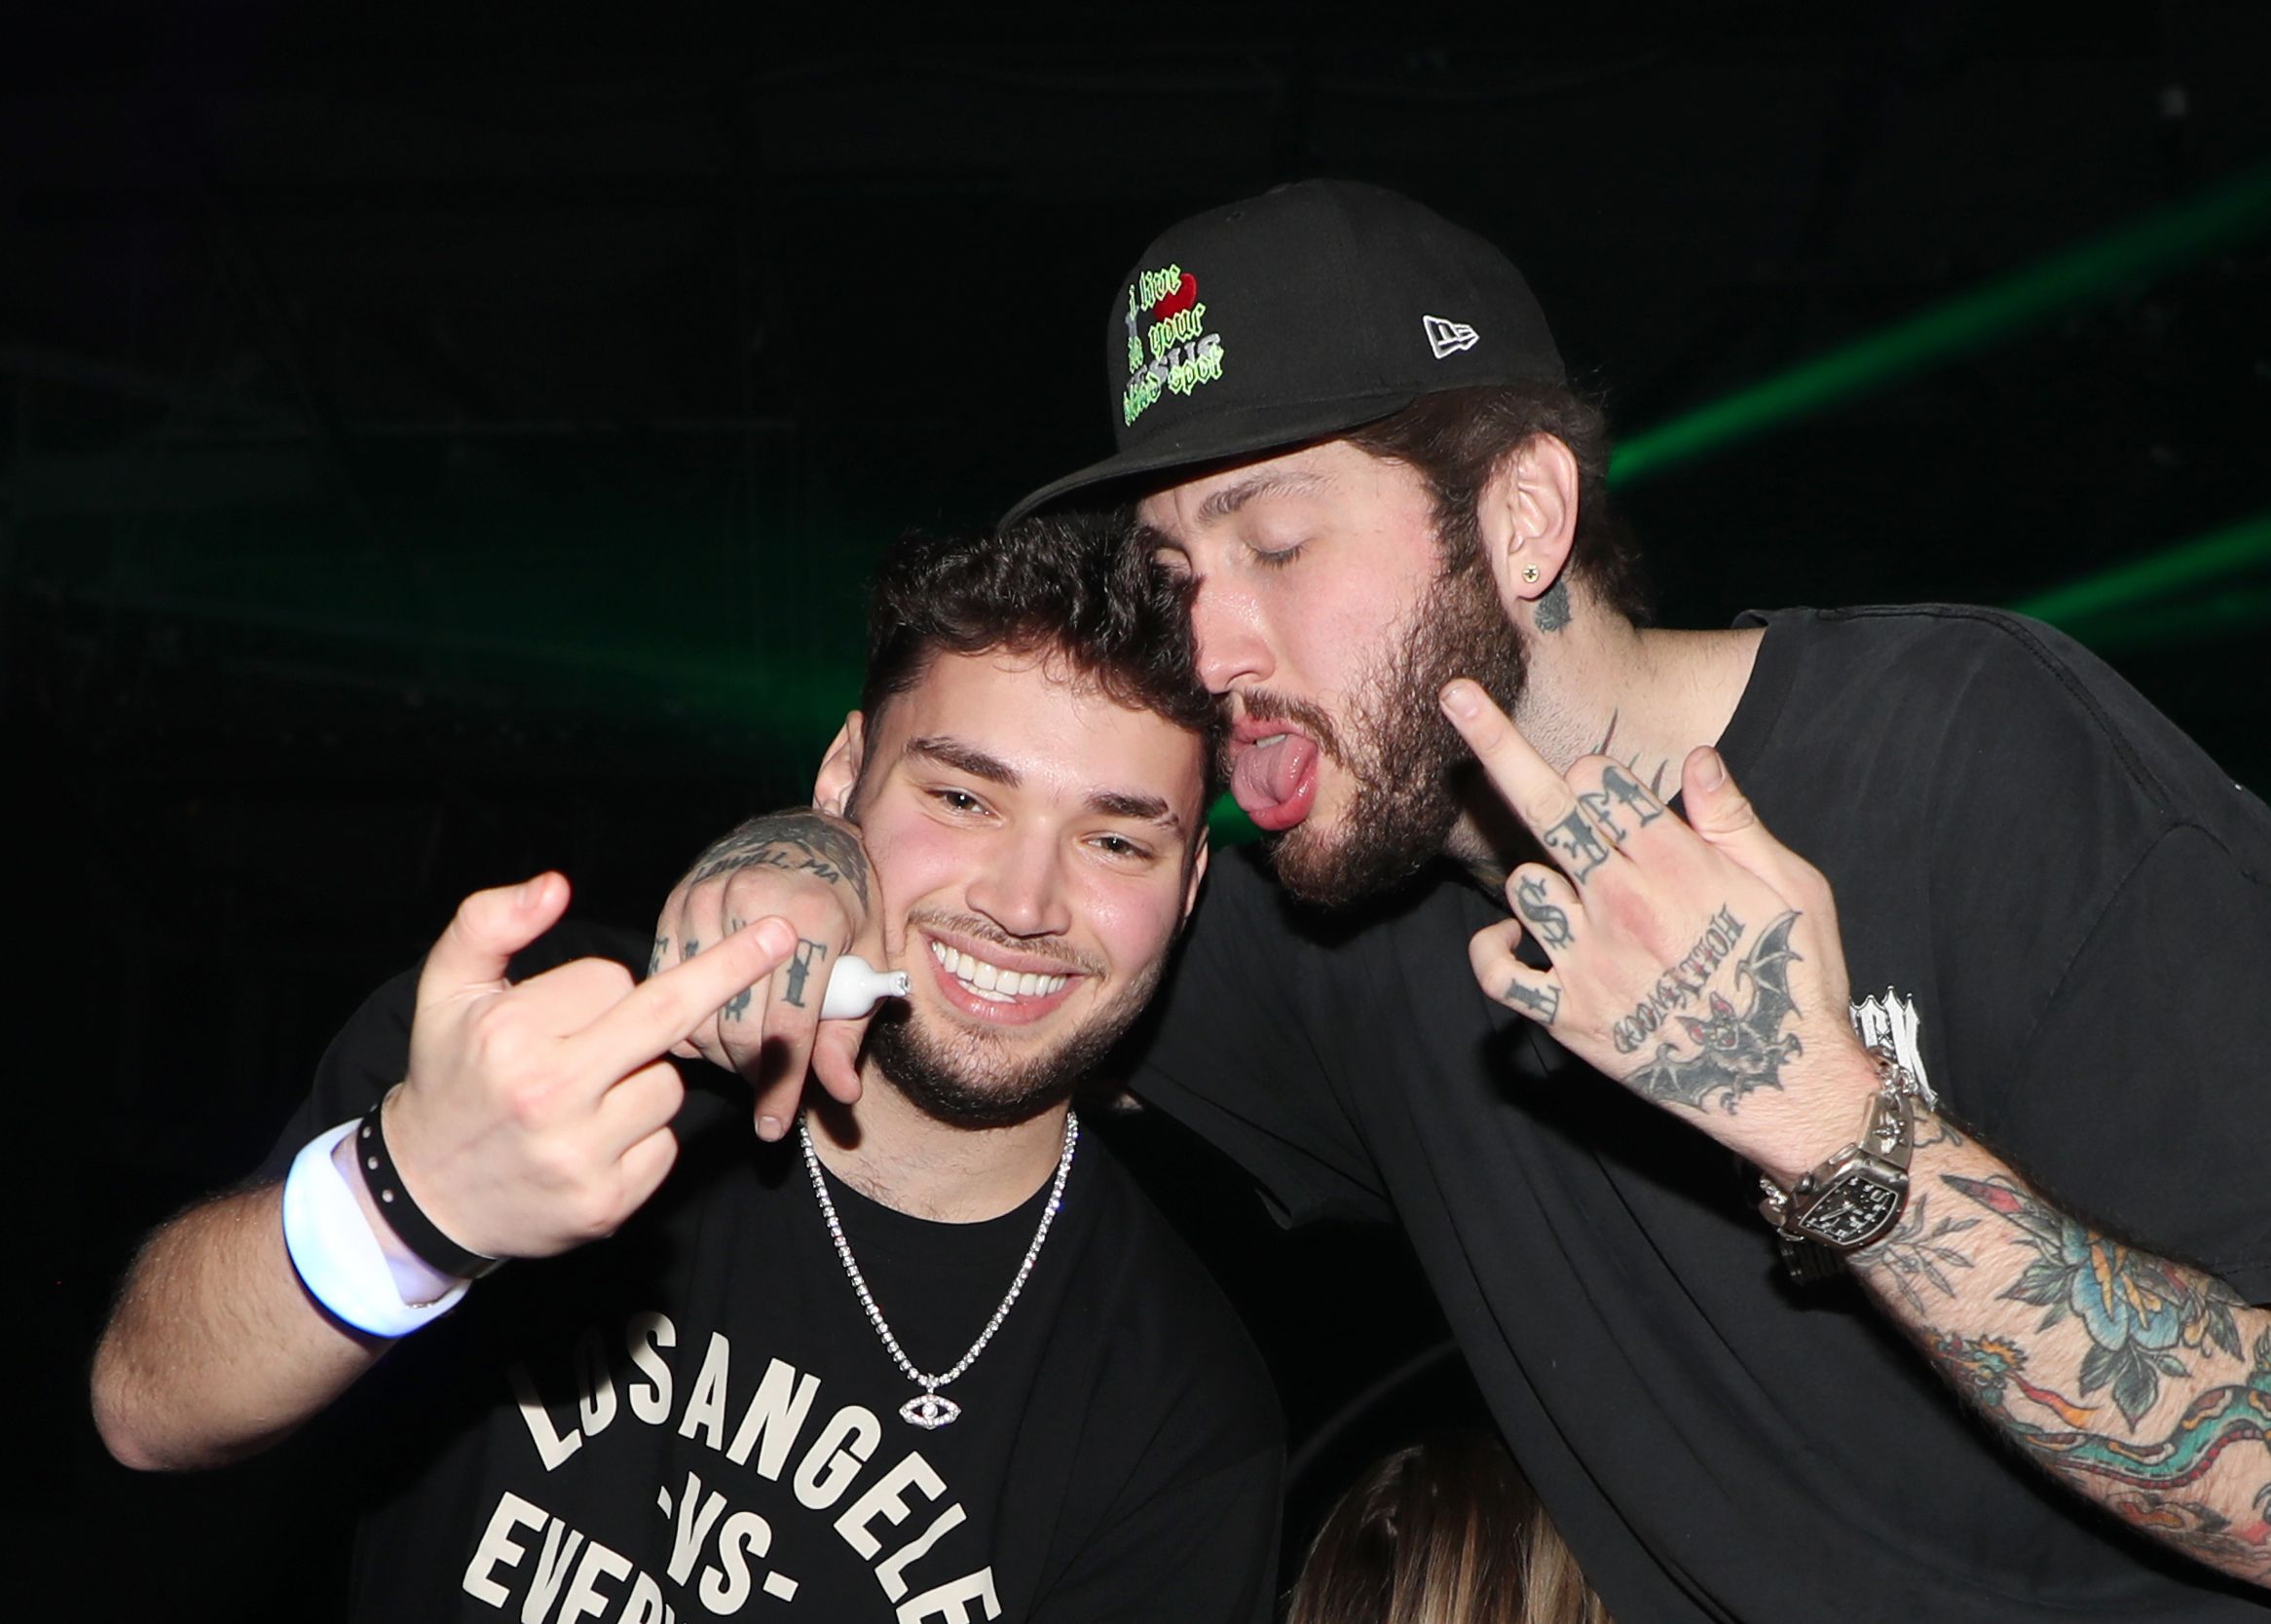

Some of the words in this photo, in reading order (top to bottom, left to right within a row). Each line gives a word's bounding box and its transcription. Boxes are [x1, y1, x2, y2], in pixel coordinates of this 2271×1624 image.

[1147, 302, 1207, 361] your
[1168, 343, 1225, 397] spot
[1613, 903, 1746, 1054] HOLLYWOOD
